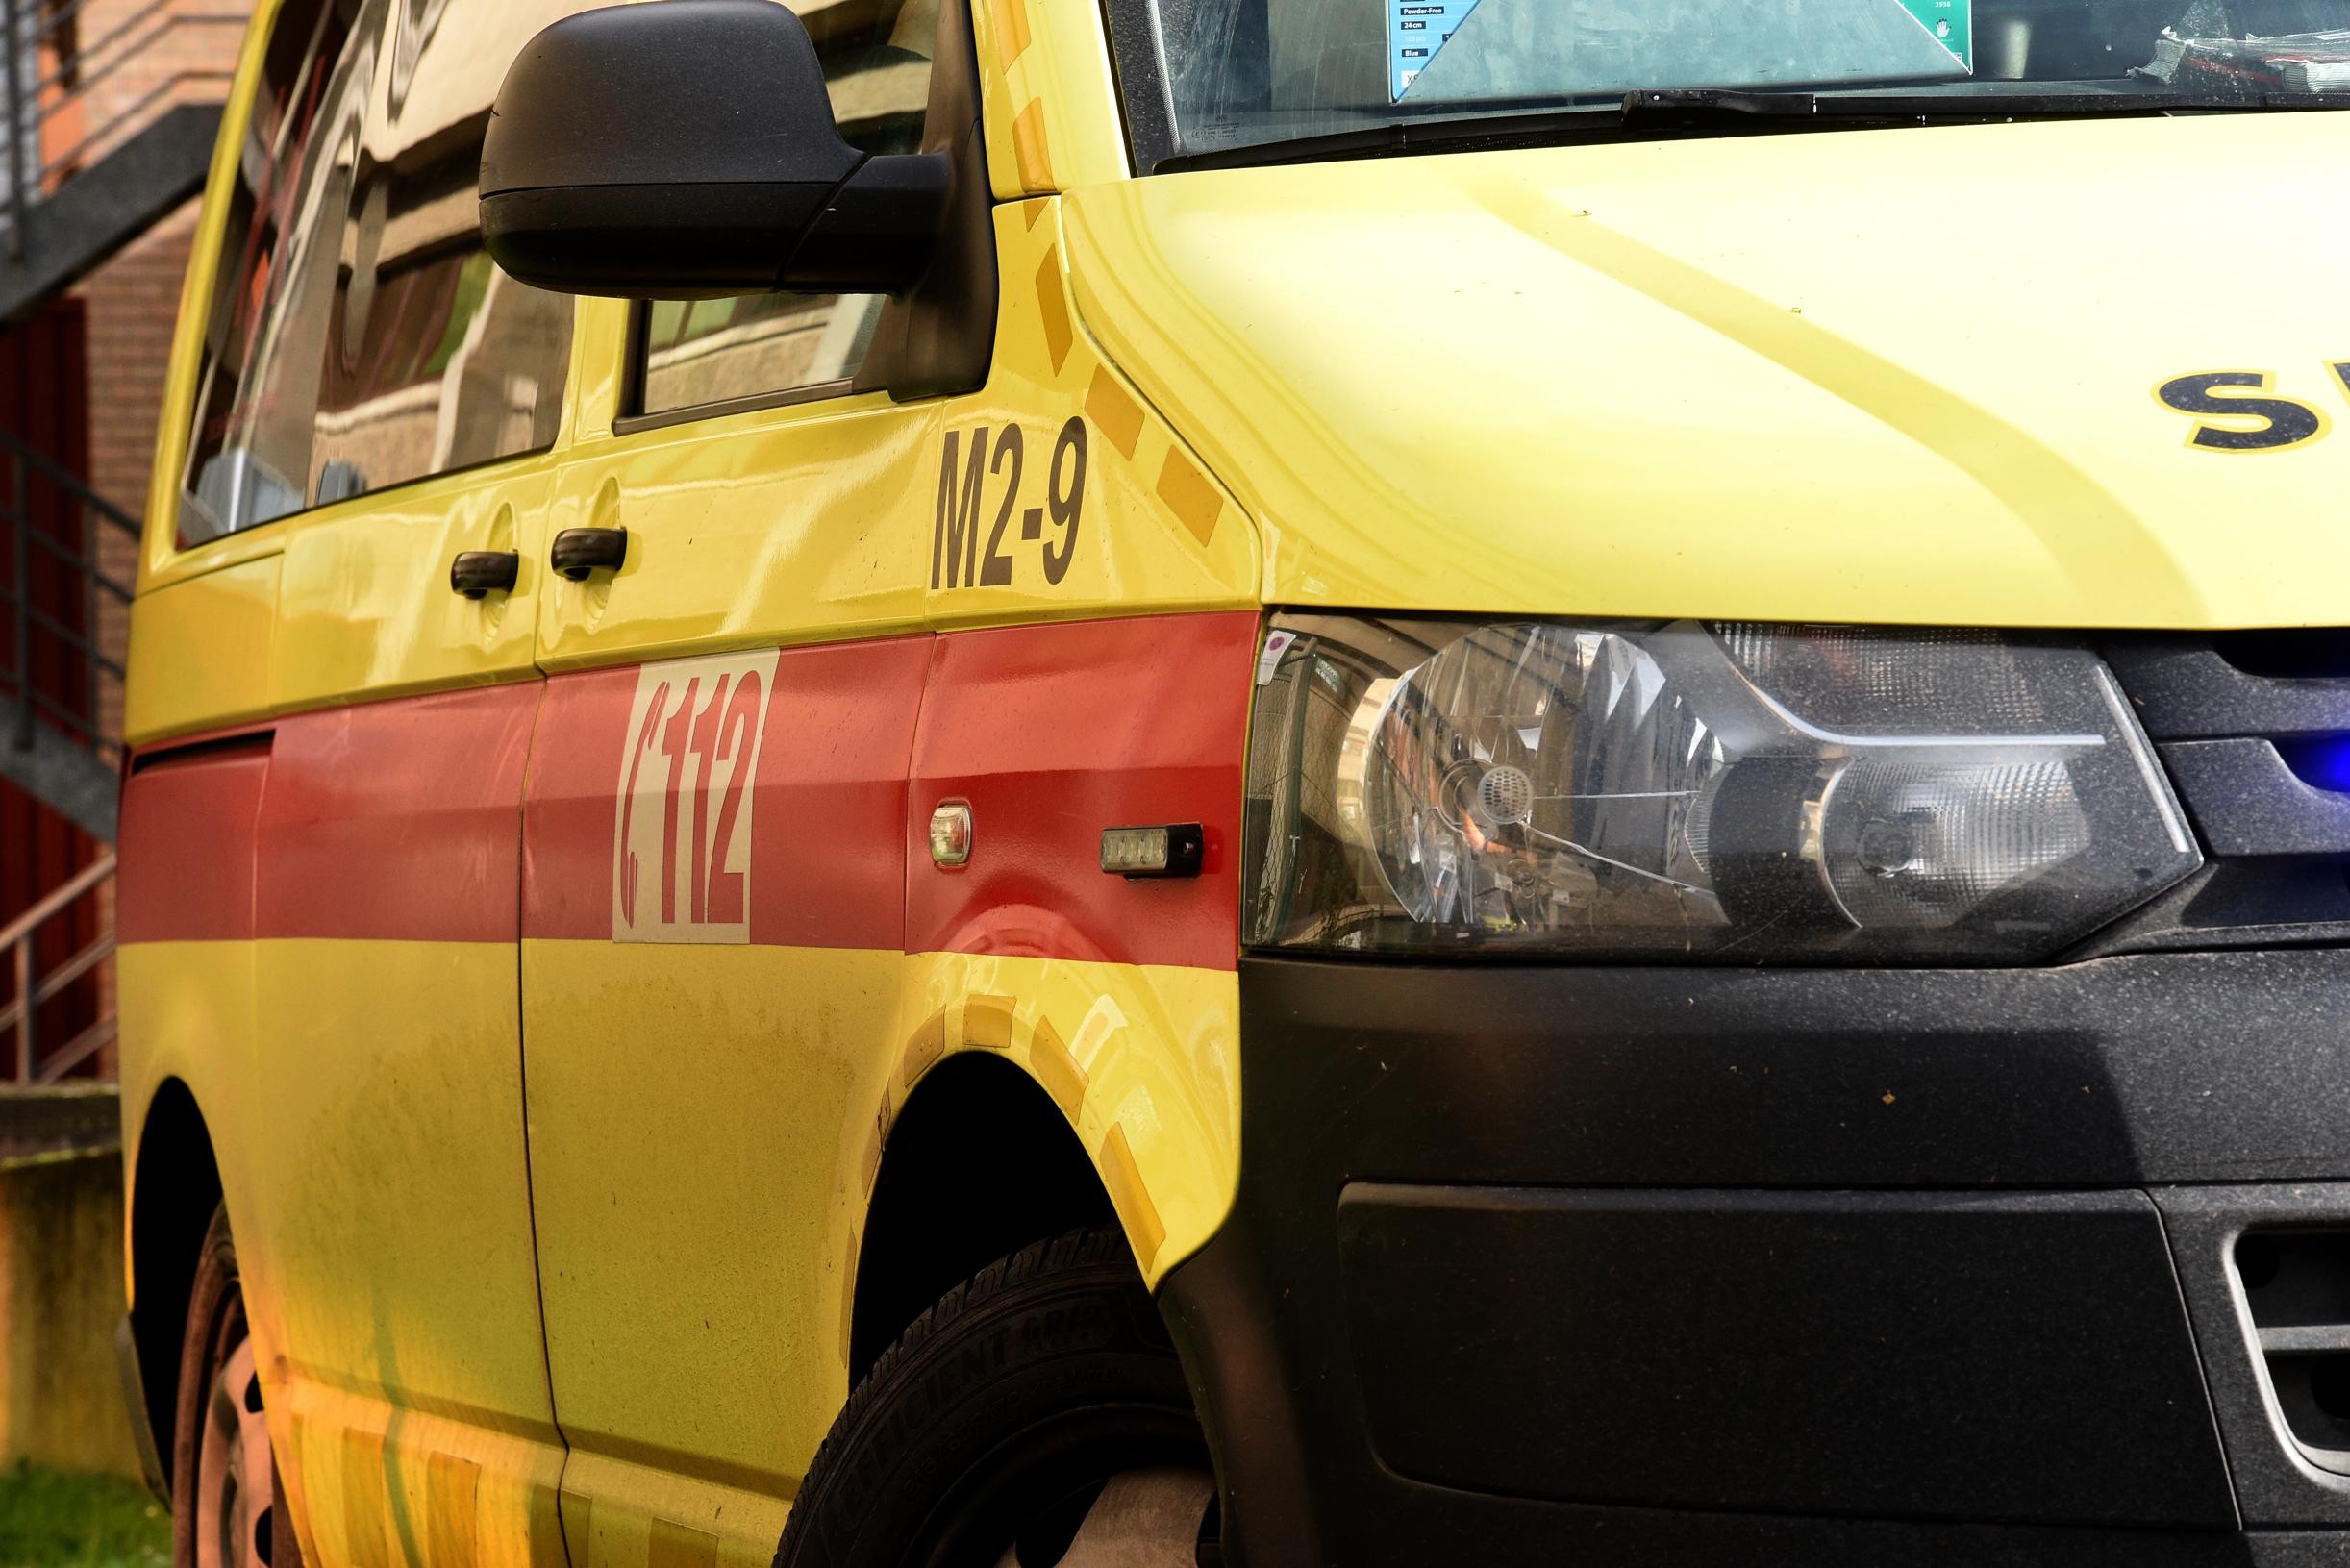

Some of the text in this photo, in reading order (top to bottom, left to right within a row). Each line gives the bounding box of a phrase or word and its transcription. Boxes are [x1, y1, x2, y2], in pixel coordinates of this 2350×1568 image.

[1403, 7, 1442, 15] Powder-Free
[2159, 362, 2350, 450] S
[930, 415, 1088, 590] M2-9
[661, 669, 762, 924] 112
